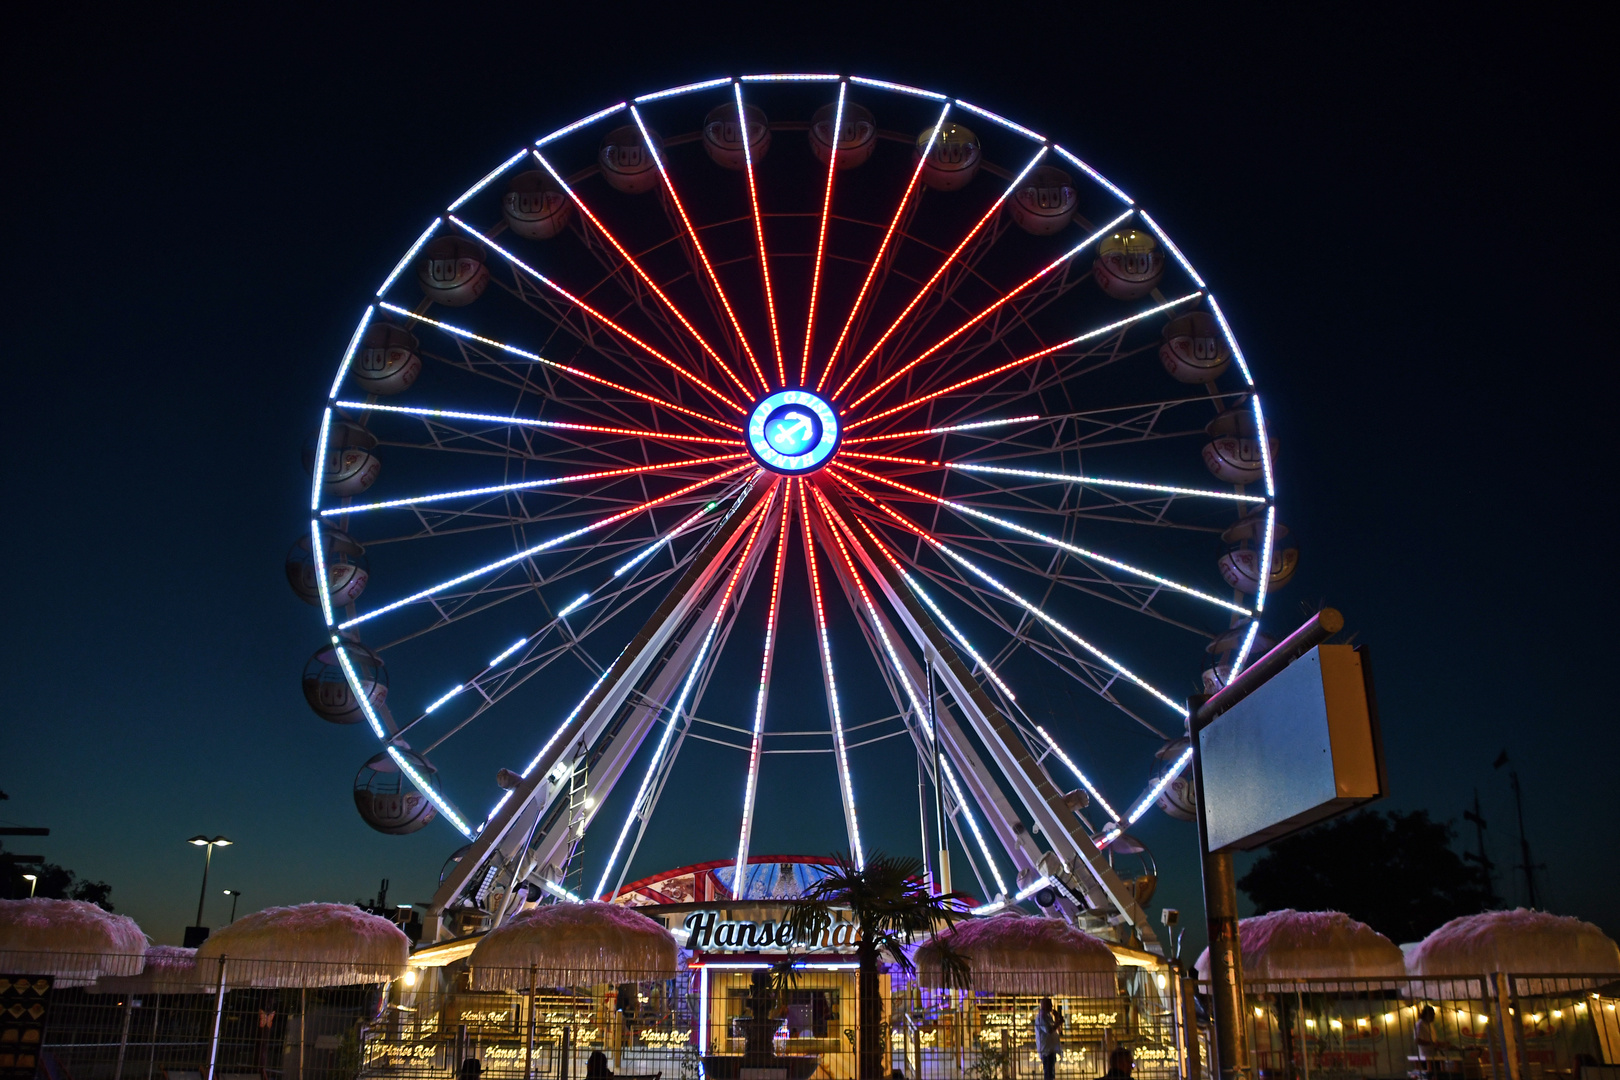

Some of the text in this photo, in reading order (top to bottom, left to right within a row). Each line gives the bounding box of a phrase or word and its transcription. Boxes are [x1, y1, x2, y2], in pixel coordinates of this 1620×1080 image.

[750, 391, 837, 468] HANSE RAD GEISLER
[685, 912, 794, 950] Hanse
[639, 1028, 692, 1044] Hanse Rad
[413, 1043, 438, 1059] Rad
[484, 1044, 517, 1059] Hanse
